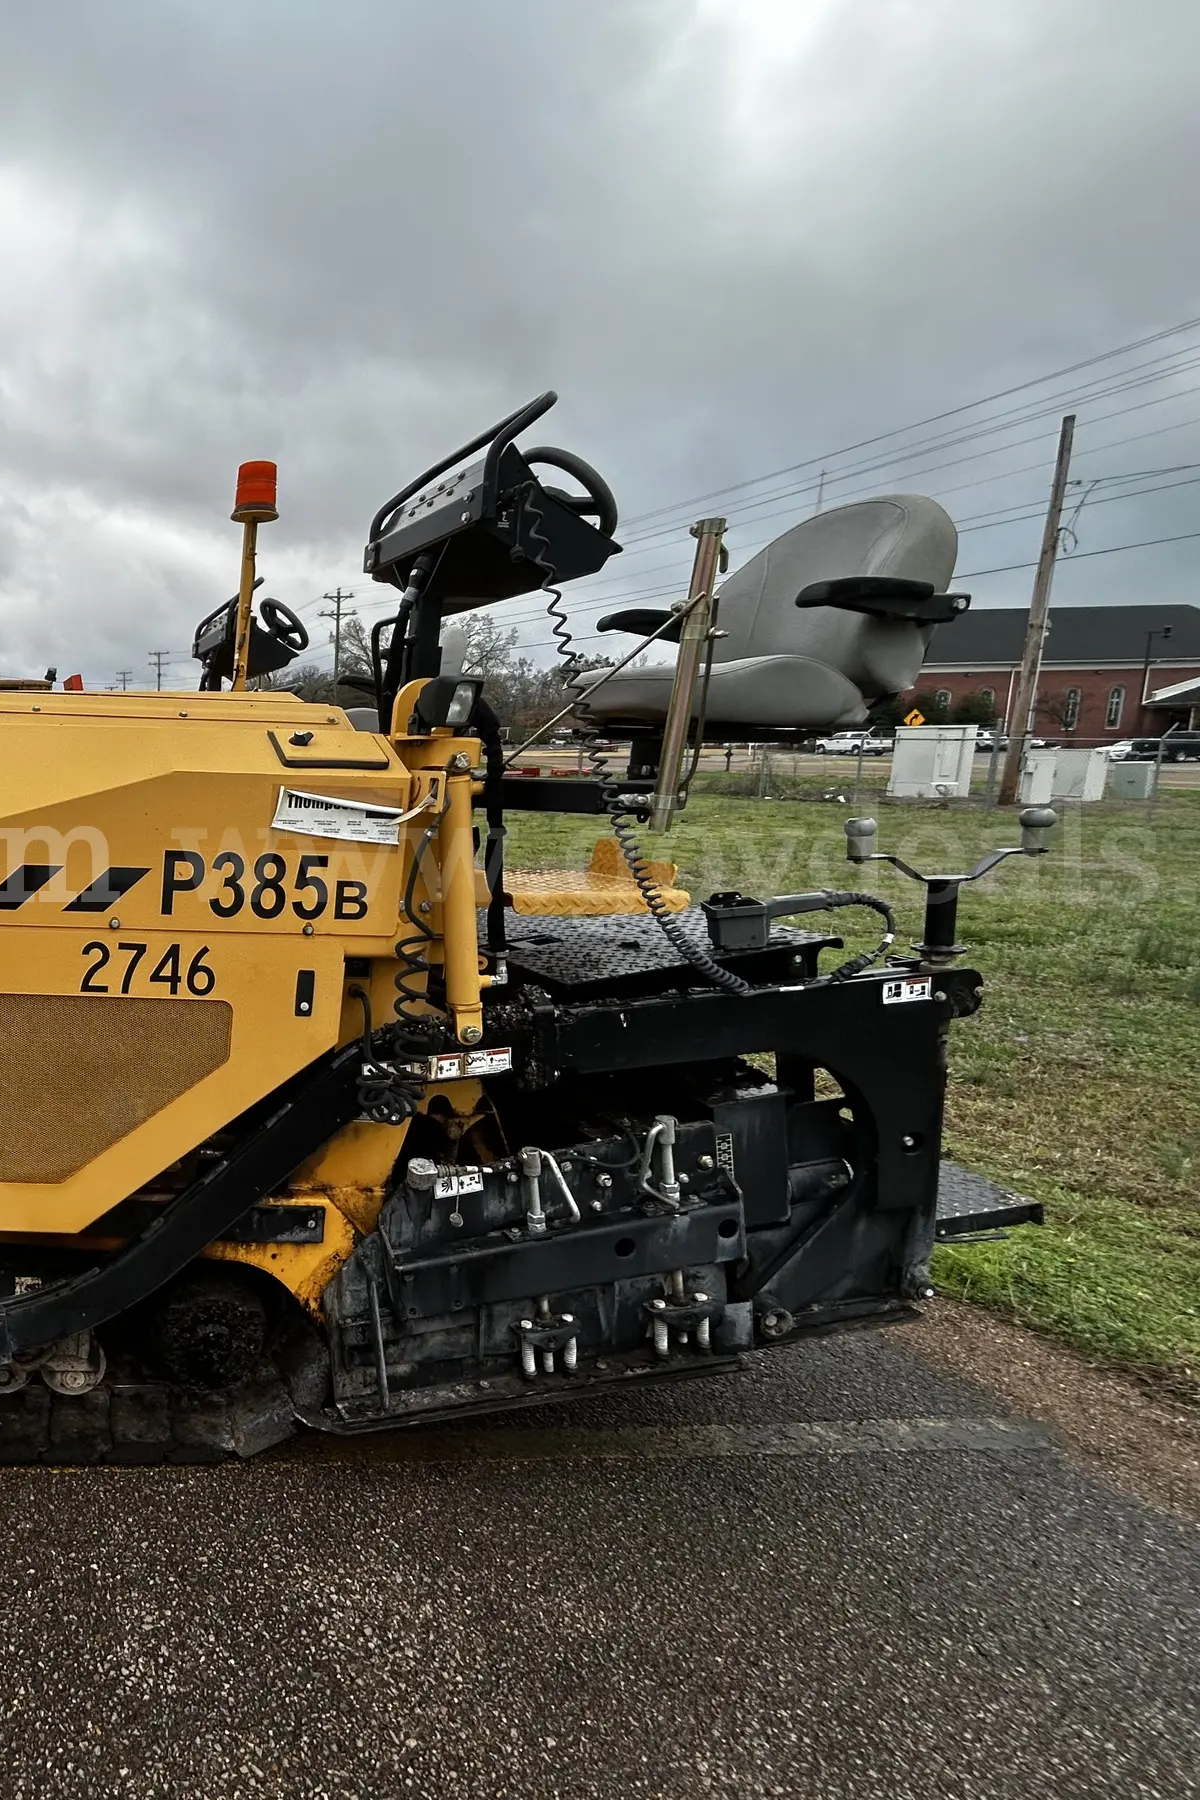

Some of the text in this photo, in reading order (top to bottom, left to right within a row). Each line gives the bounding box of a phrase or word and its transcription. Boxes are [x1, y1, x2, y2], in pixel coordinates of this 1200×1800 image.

[287, 793, 360, 811] Thomp
[160, 849, 369, 920] P385B
[79, 940, 216, 997] 2746
